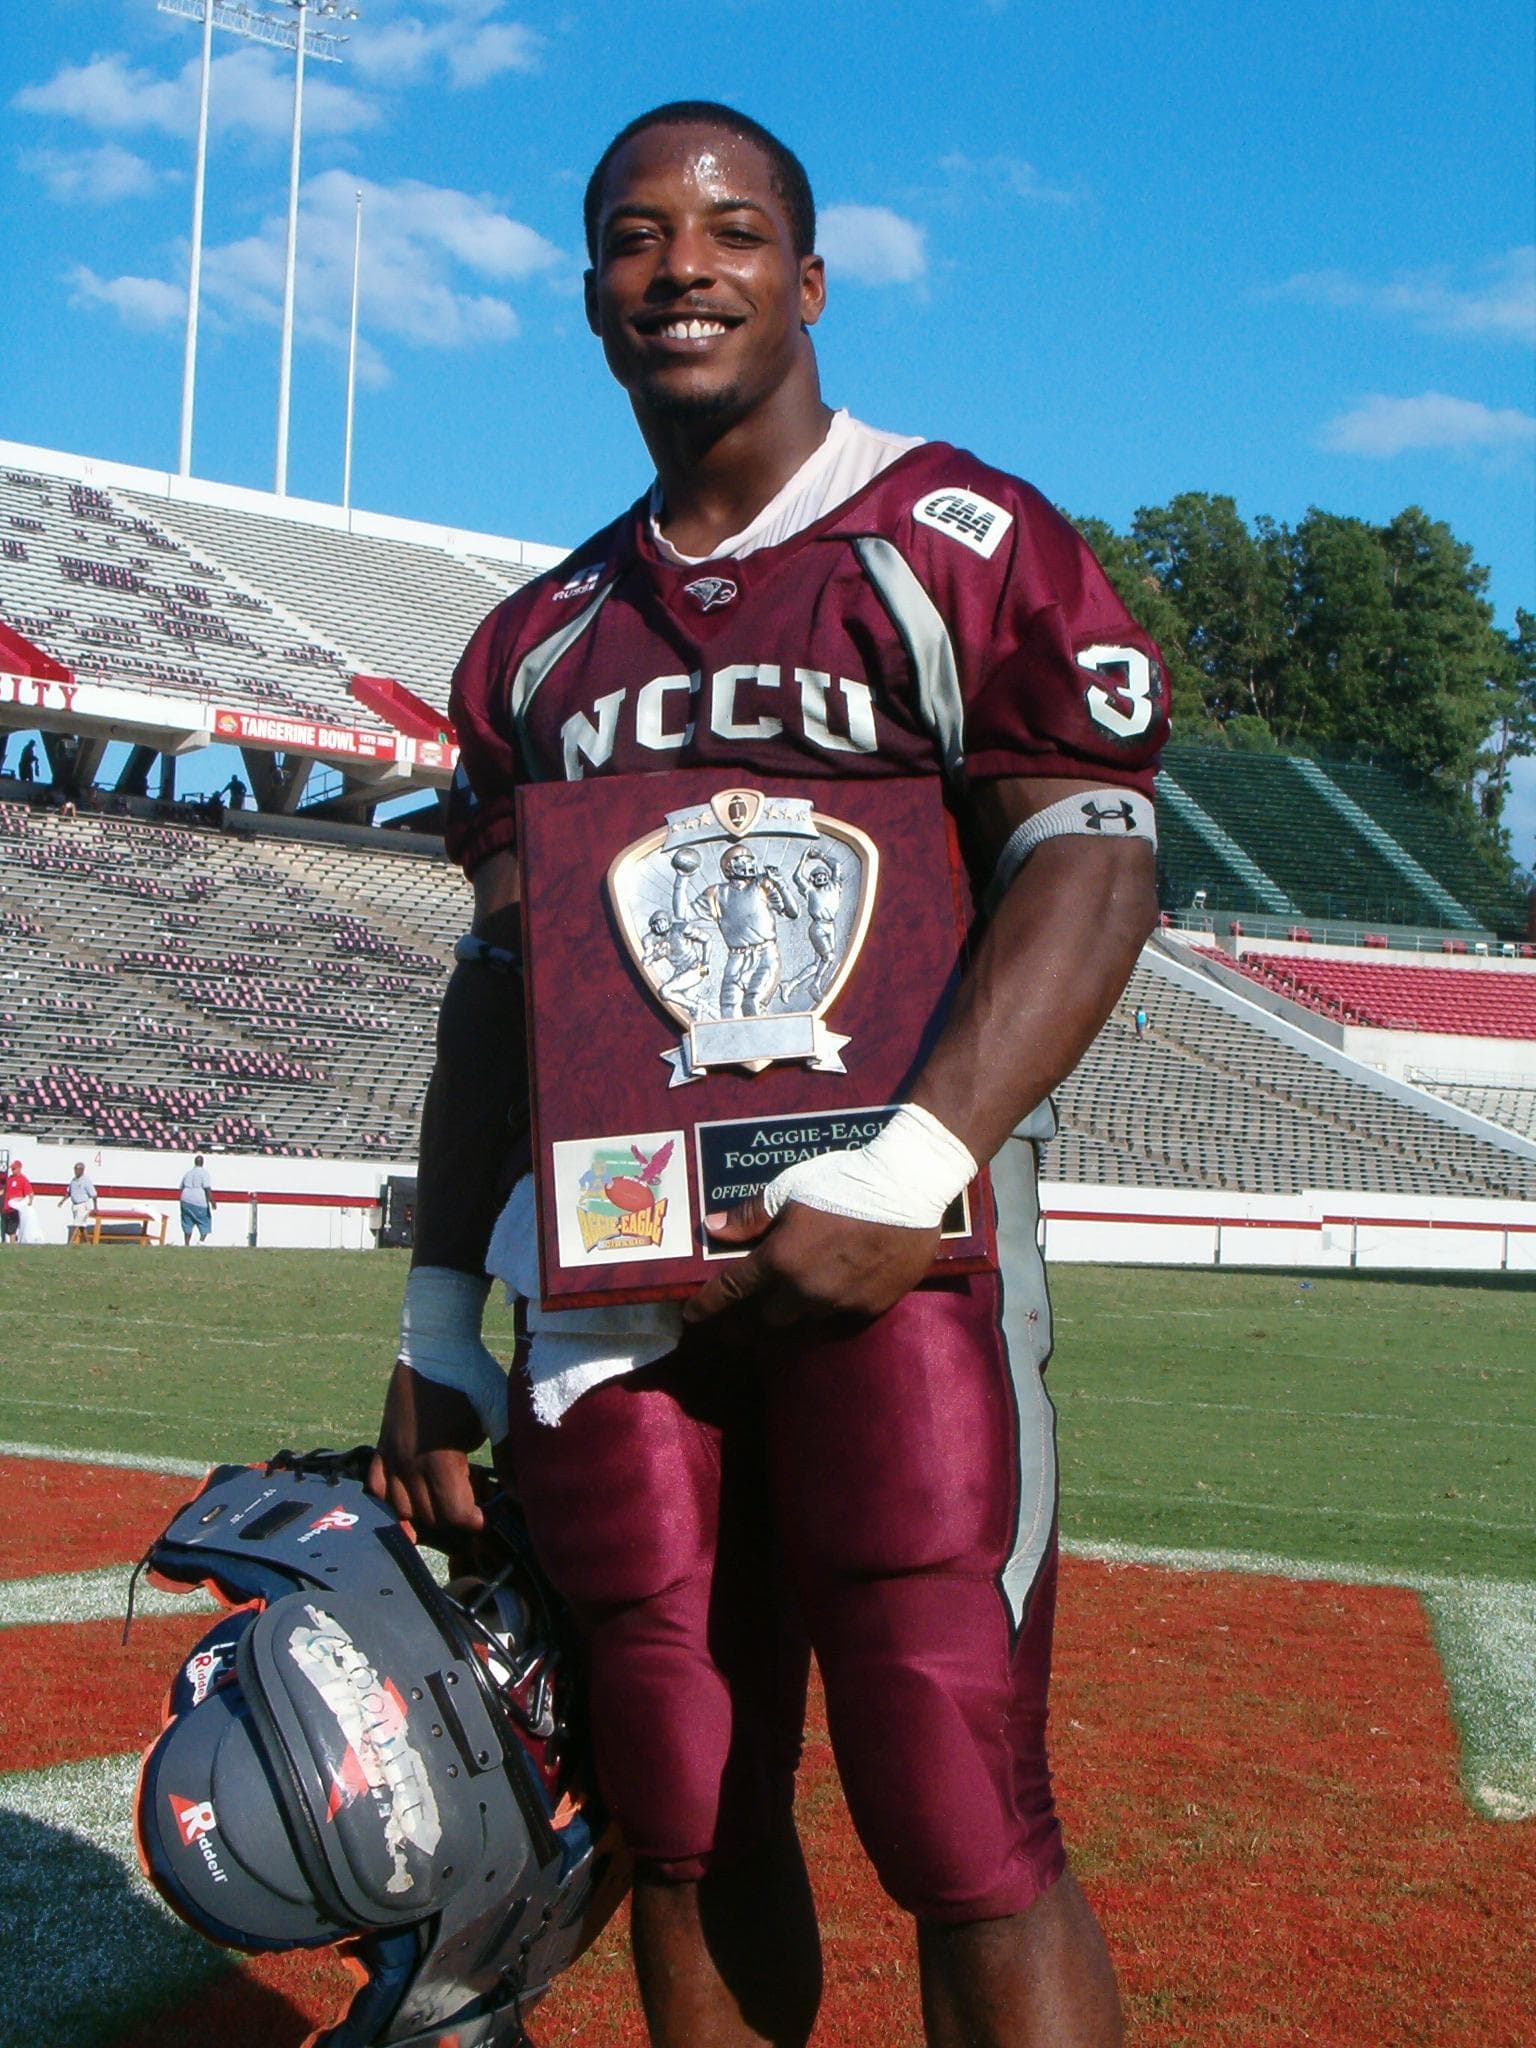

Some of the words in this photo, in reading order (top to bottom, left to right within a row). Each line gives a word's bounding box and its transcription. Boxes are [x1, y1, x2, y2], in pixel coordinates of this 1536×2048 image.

[0, 676, 78, 712] ITY
[1077, 644, 1153, 738] 3
[240, 716, 316, 746] TANGERINE
[318, 728, 357, 753] BOWL
[560, 663, 878, 782] NCCU
[94, 1151, 103, 1168] 4
[180, 1801, 229, 1883] Riddell
